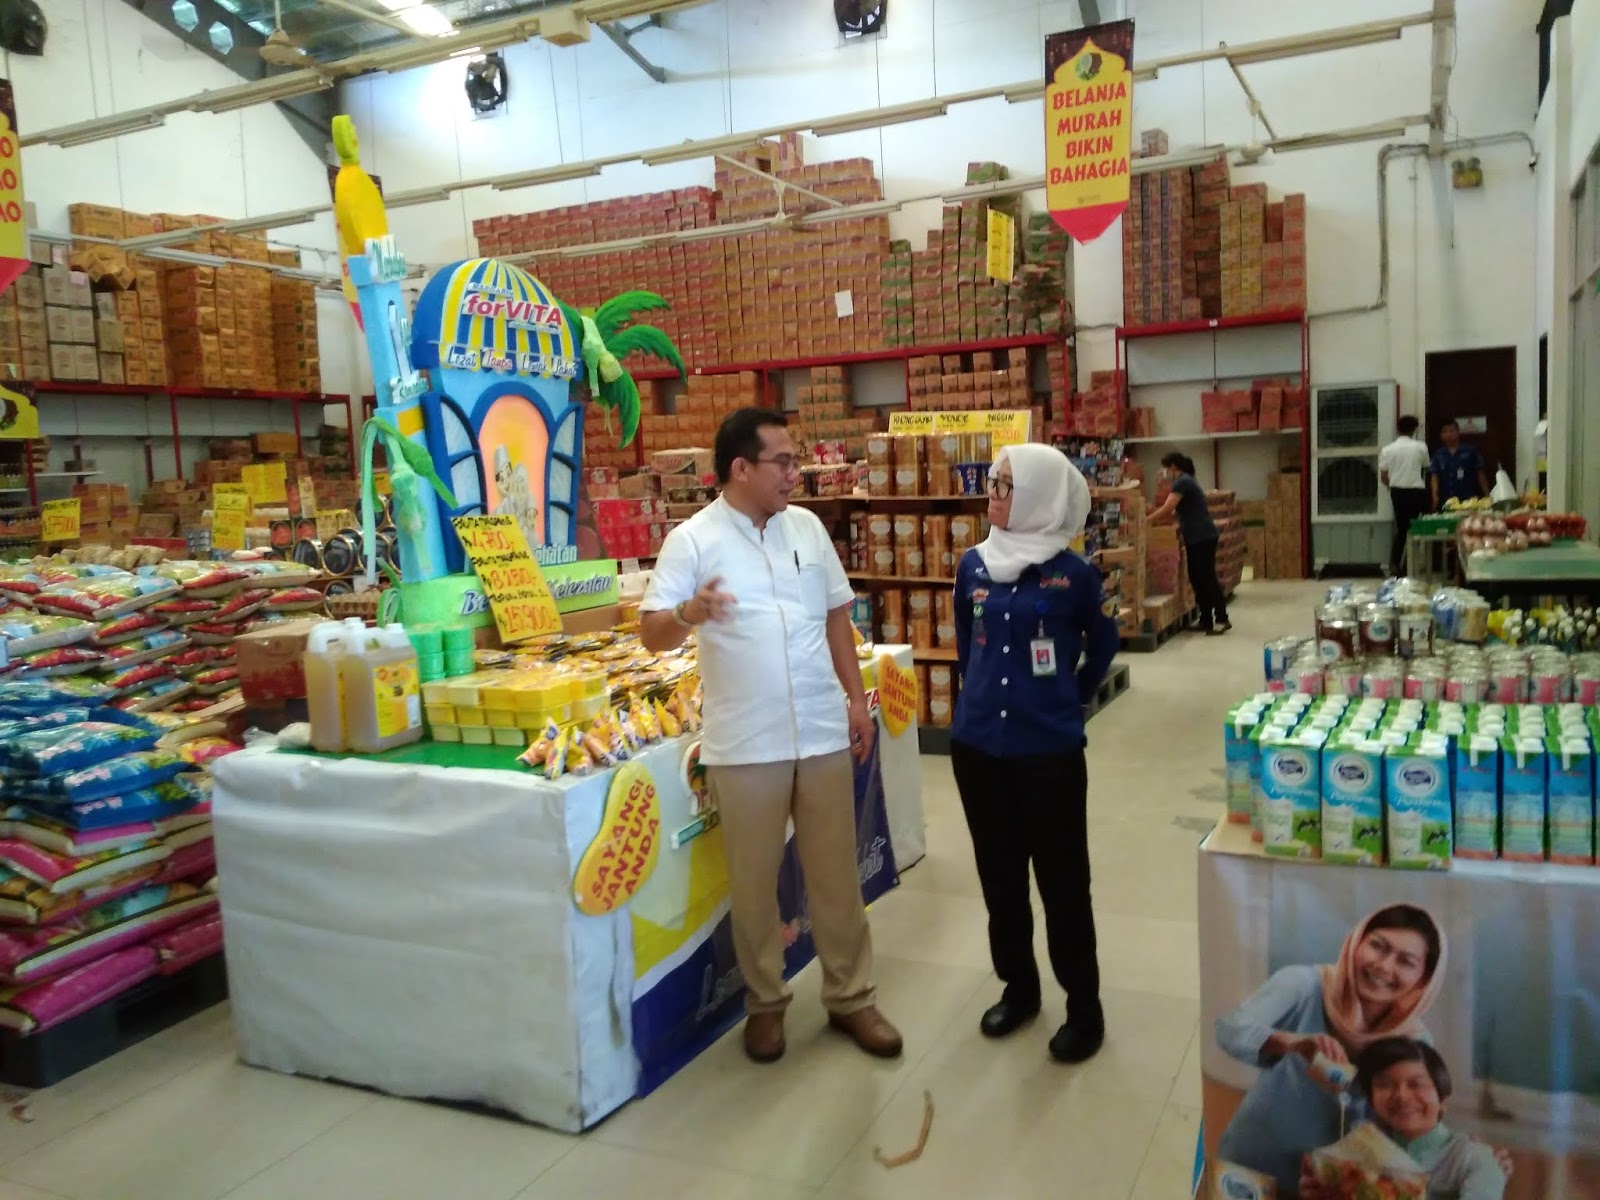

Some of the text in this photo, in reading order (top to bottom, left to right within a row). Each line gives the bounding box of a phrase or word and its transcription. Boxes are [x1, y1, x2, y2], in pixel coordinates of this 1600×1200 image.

[1053, 81, 1127, 110] BELANJA
[1057, 109, 1122, 136] MURAH
[1065, 135, 1113, 159] BIKIN
[1050, 157, 1128, 186] BAHAGIA
[466, 295, 562, 326] forVITA
[592, 779, 645, 898] SAYANGI
[603, 784, 656, 911] JANTUNG
[625, 819, 660, 896] ANDA
